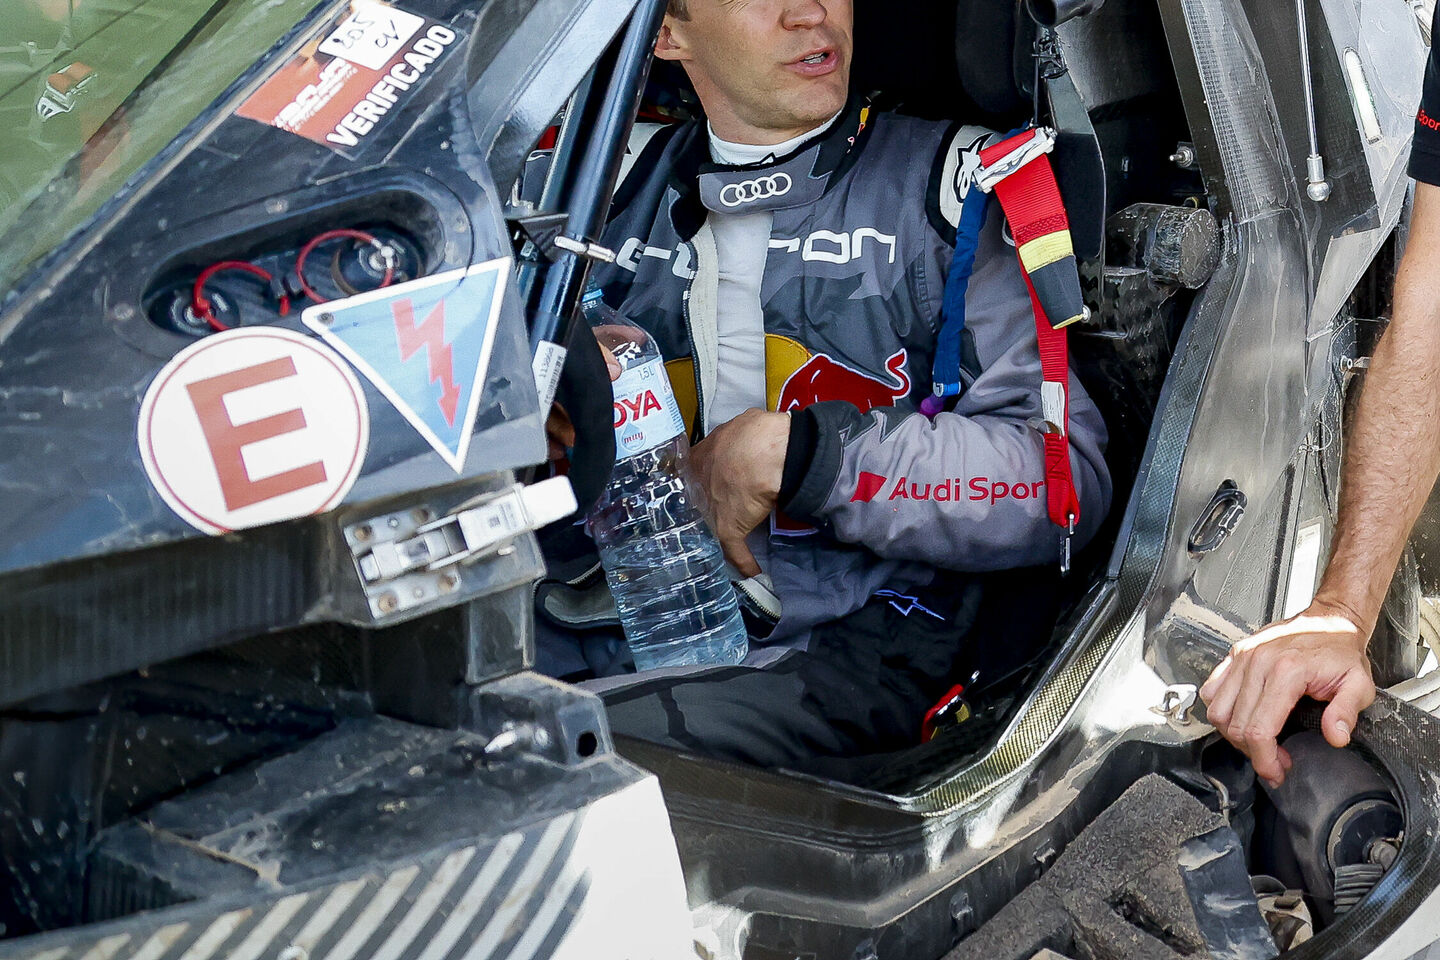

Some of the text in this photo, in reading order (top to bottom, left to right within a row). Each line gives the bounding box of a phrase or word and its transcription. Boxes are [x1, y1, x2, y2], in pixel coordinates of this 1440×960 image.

[326, 25, 456, 147] VERIFICADO
[185, 355, 328, 512] E
[888, 476, 1047, 505] Audi Spor
